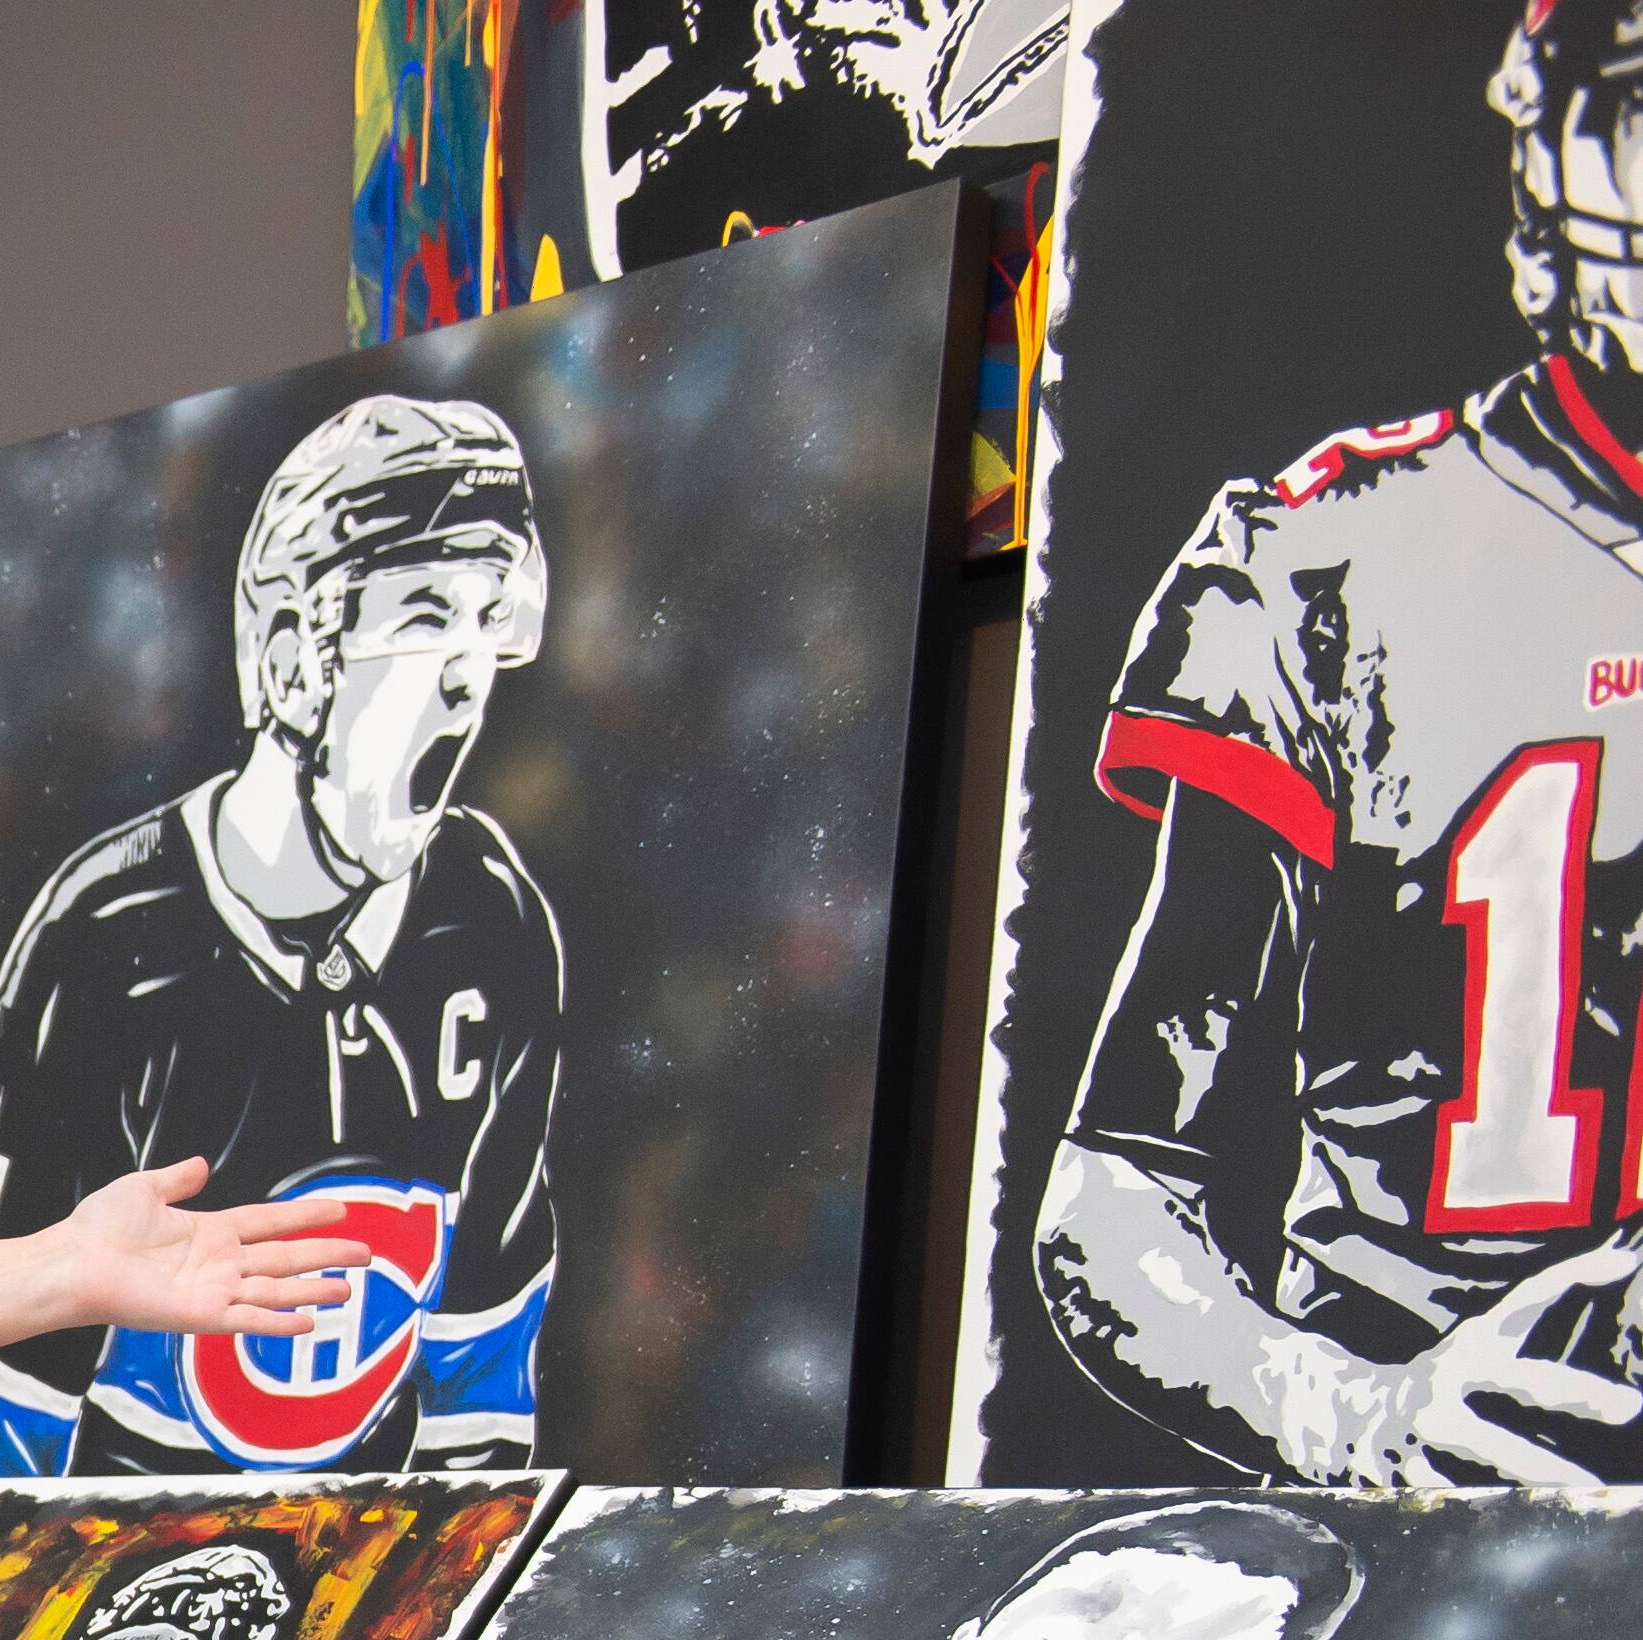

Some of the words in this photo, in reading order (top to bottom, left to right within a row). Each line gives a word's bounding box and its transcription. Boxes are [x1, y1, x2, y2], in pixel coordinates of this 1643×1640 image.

[1588, 656, 1643, 707] BU
[1422, 736, 1643, 1236] 1
[437, 988, 527, 1101] C
